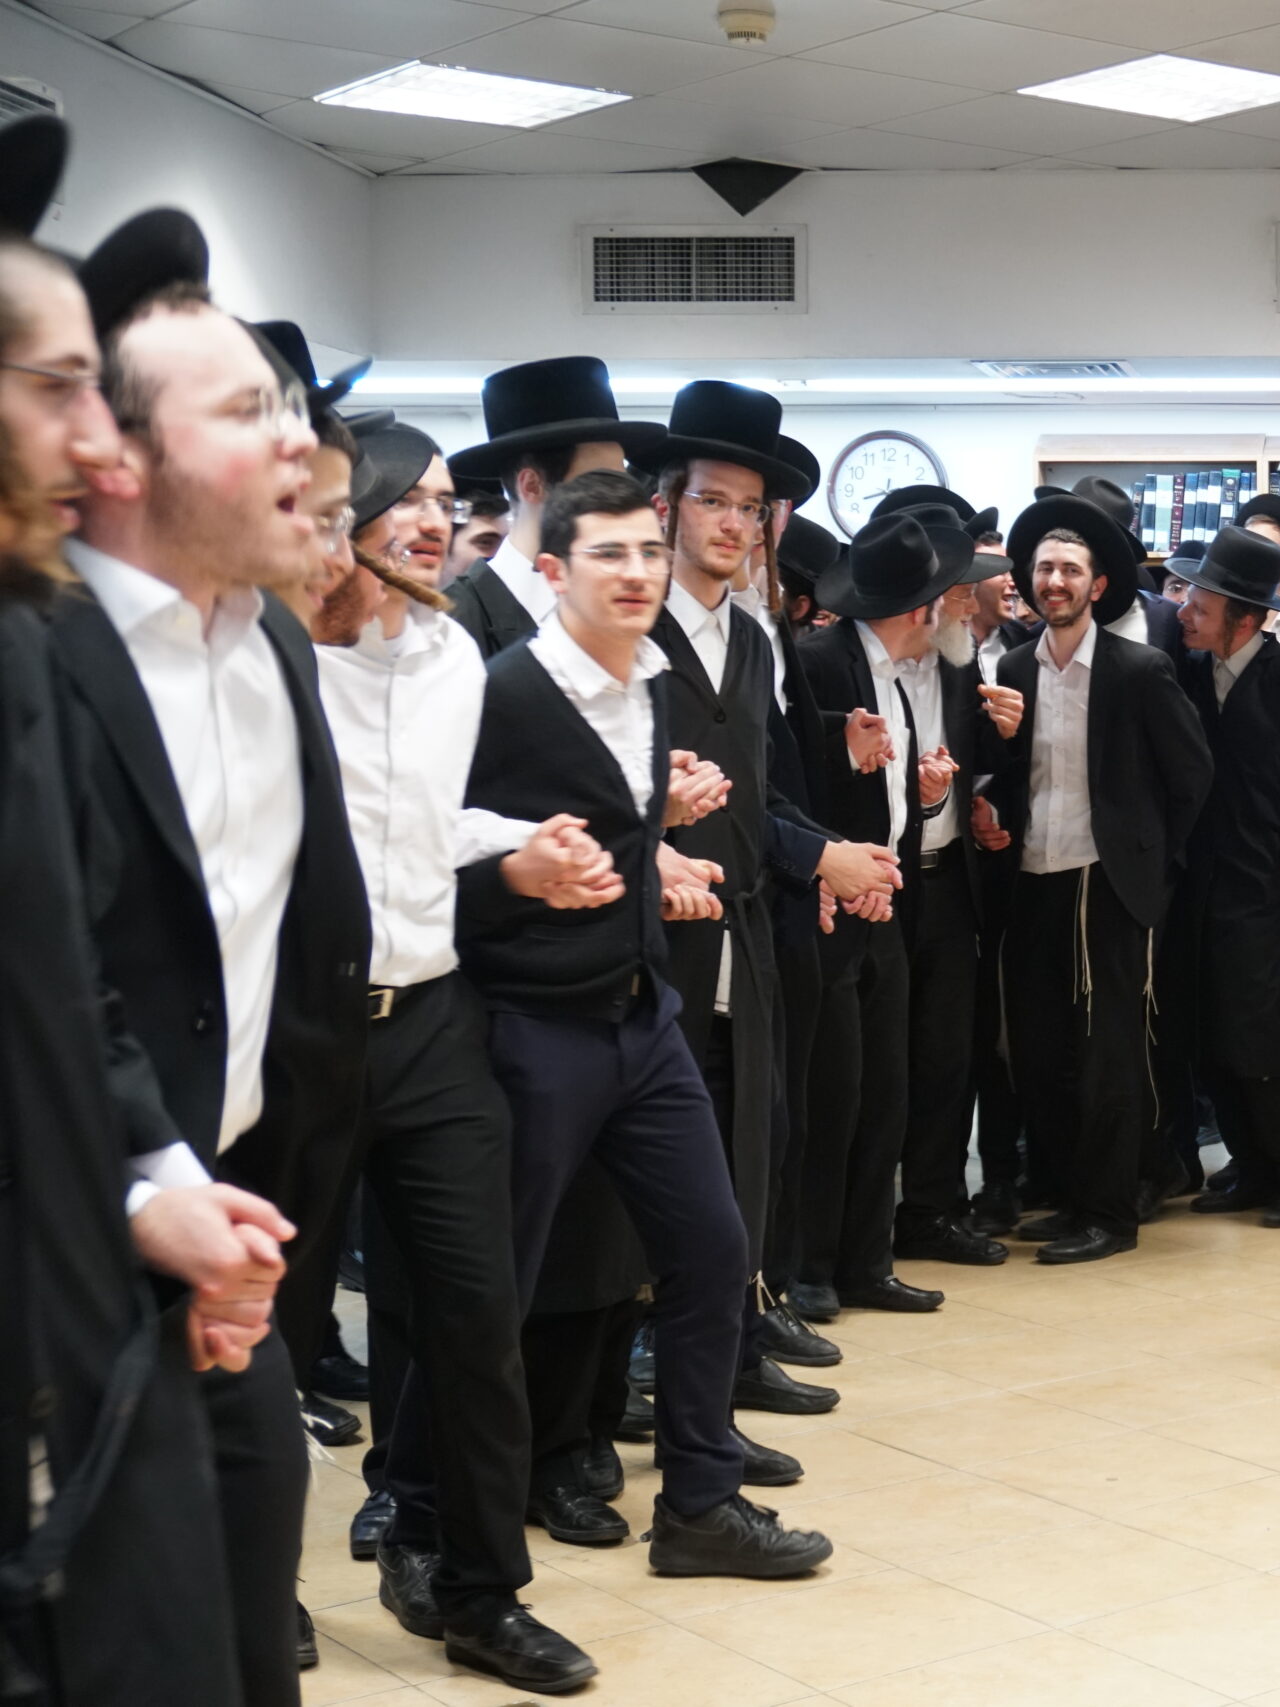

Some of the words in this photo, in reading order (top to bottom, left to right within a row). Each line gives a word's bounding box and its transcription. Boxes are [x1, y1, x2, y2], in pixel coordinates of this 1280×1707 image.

[863, 453, 875, 466] 11
[881, 448, 896, 461] 12
[904, 454, 910, 466] 1
[849, 466, 864, 480] 10
[915, 467, 925, 480] 2
[844, 483, 854, 497] 9
